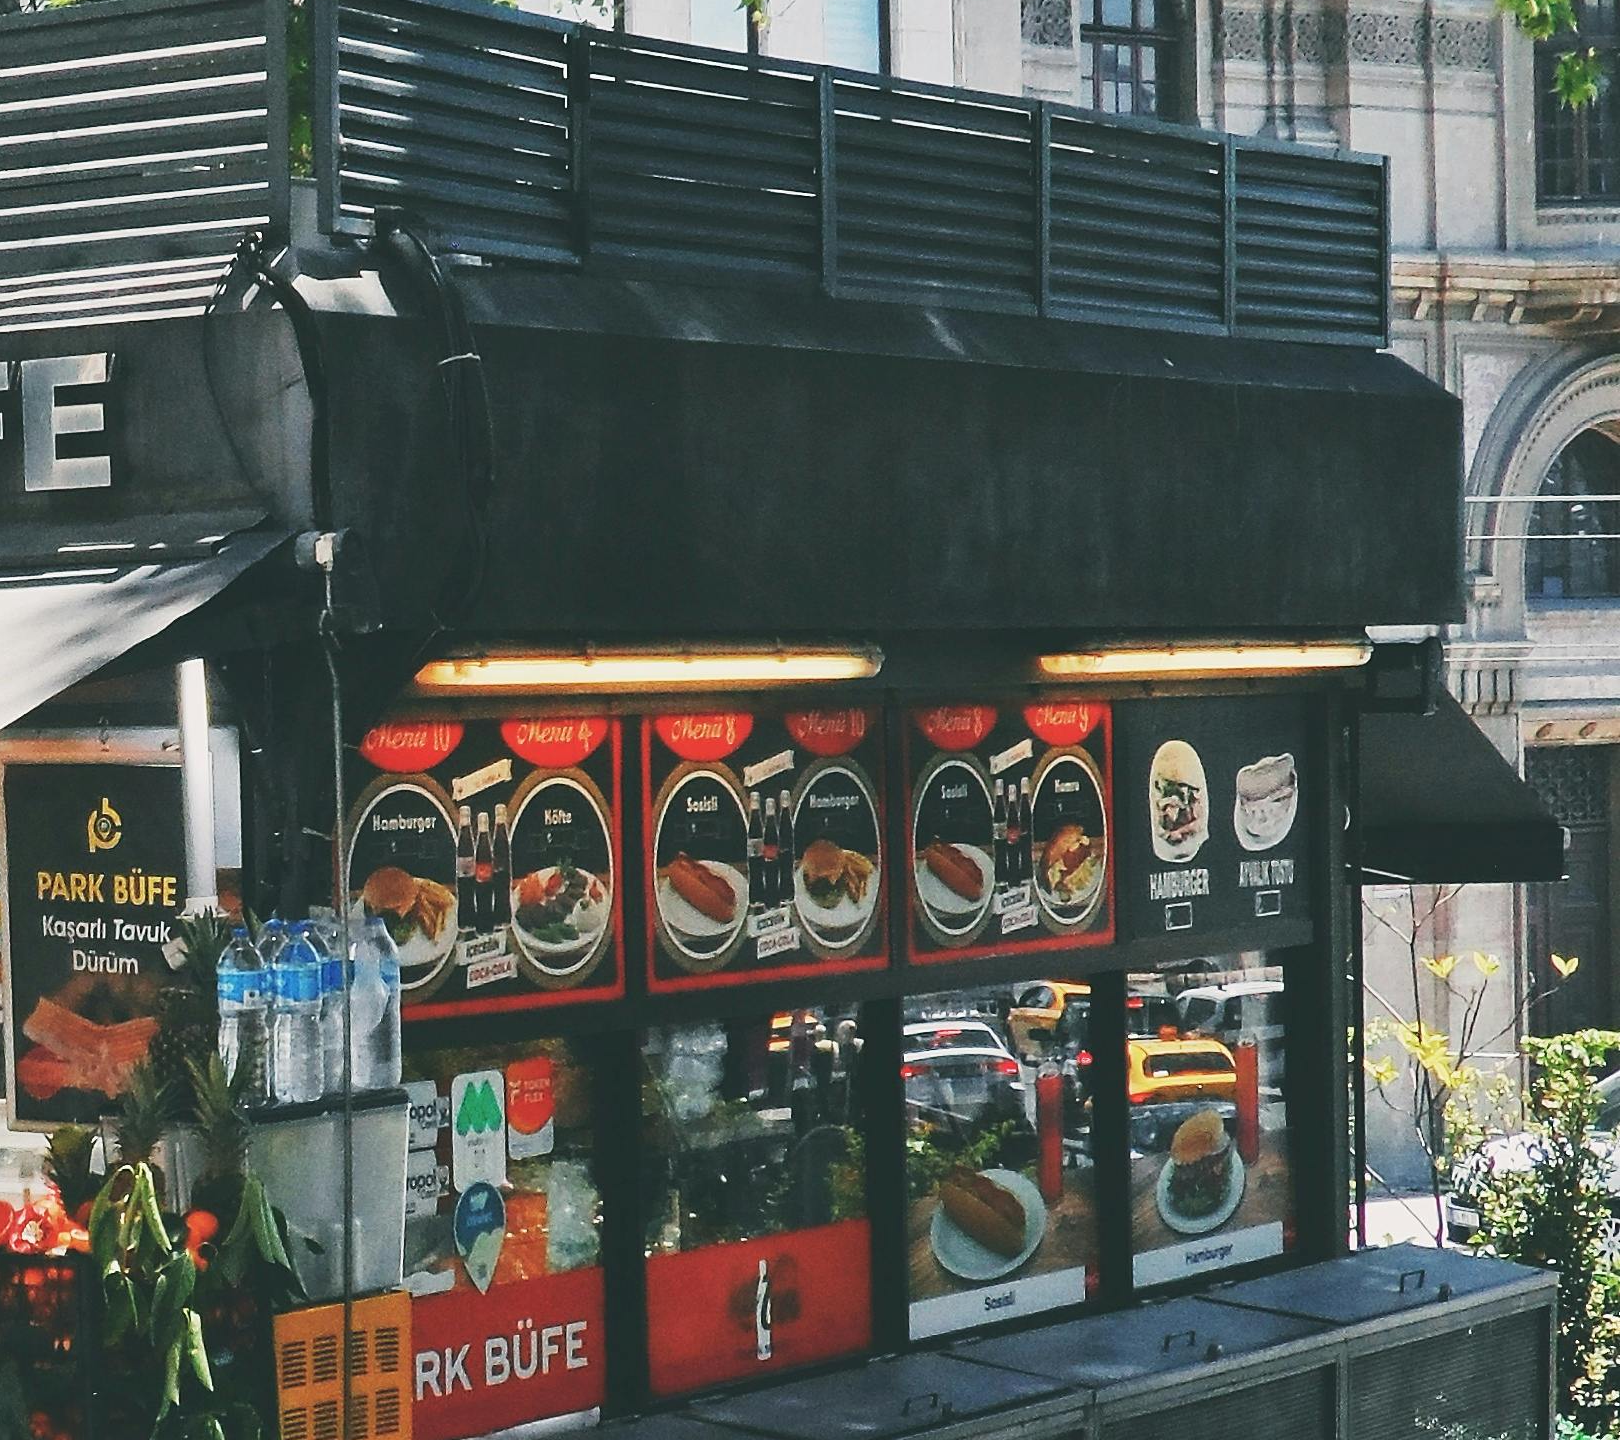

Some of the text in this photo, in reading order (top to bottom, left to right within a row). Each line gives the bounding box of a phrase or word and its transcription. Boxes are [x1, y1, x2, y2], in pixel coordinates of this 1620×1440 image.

[372, 814, 437, 833] Hamburger
[544, 809, 573, 826] Köfte
[37, 867, 177, 908] PARK BÜFE
[42, 914, 172, 944] Kaşarlı Tavuk
[72, 949, 139, 975] Dürüm
[415, 1318, 589, 1401] RK BÜFE
